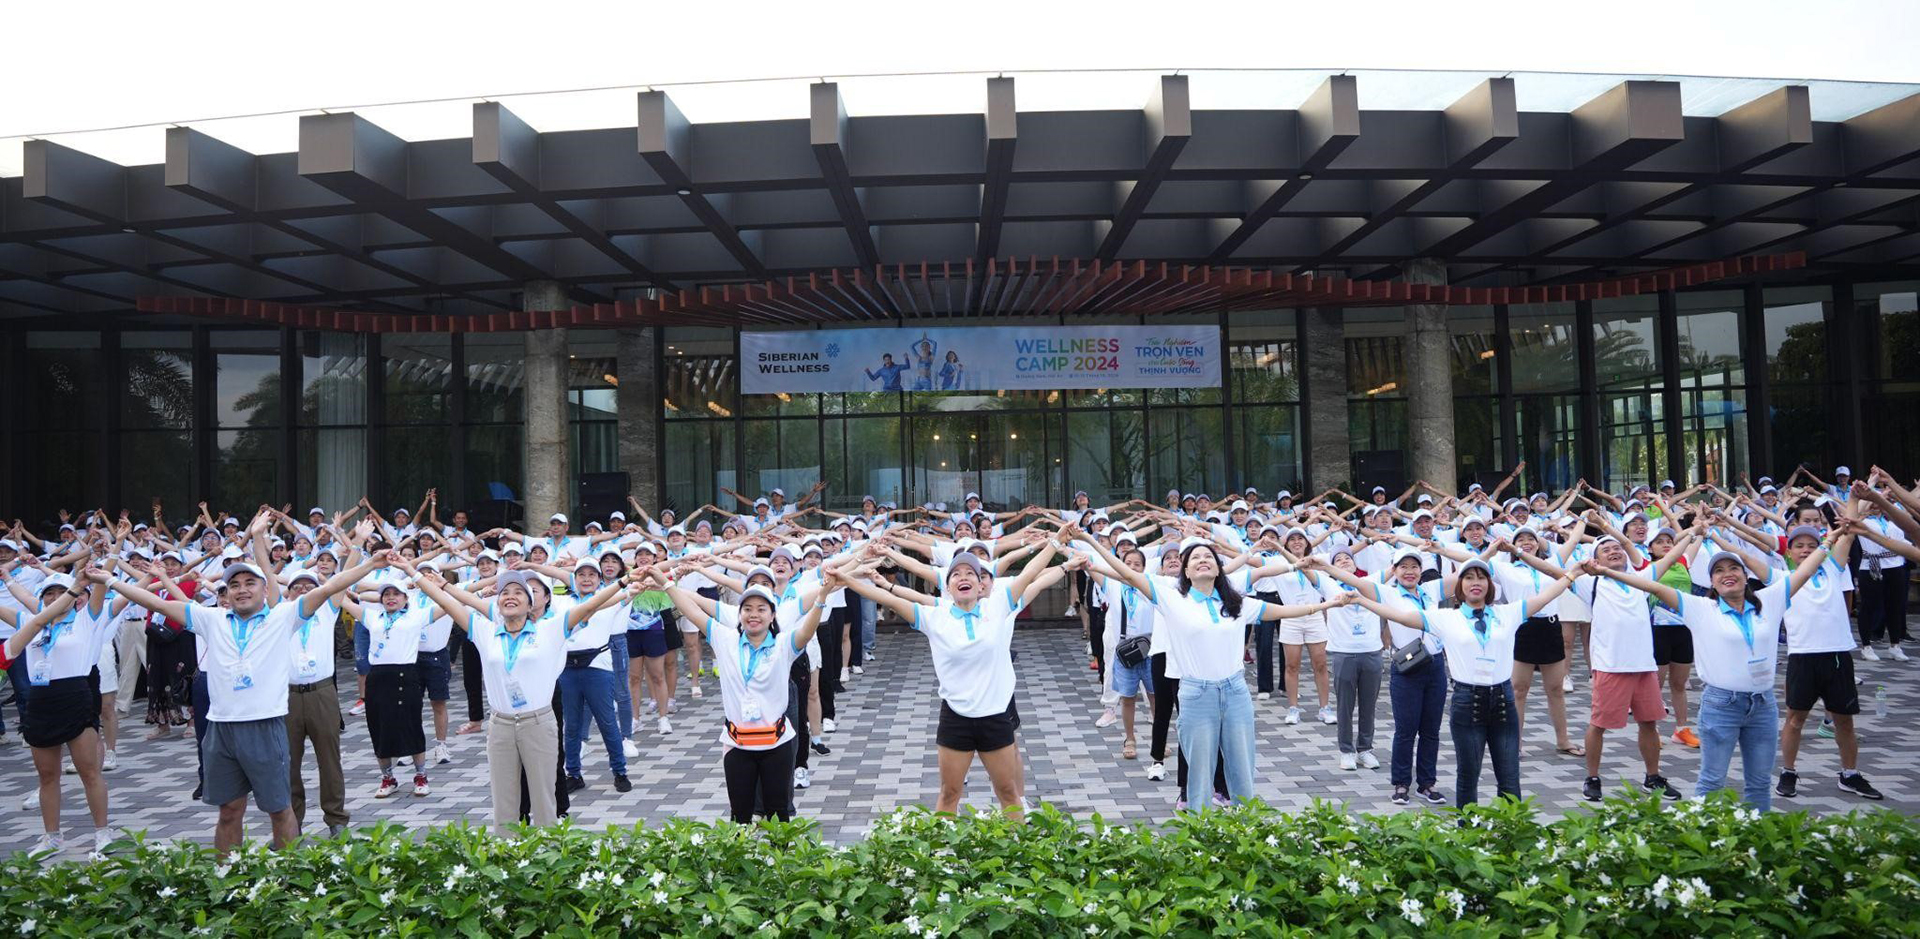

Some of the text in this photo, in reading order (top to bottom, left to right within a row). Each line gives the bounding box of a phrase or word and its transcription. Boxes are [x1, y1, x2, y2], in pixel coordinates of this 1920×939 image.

[1014, 338, 1120, 354] WELLNESS
[1134, 346, 1172, 359] TRỌN
[1015, 355, 1119, 372] CAMP 2024
[1138, 367, 1167, 376] THỊNH
